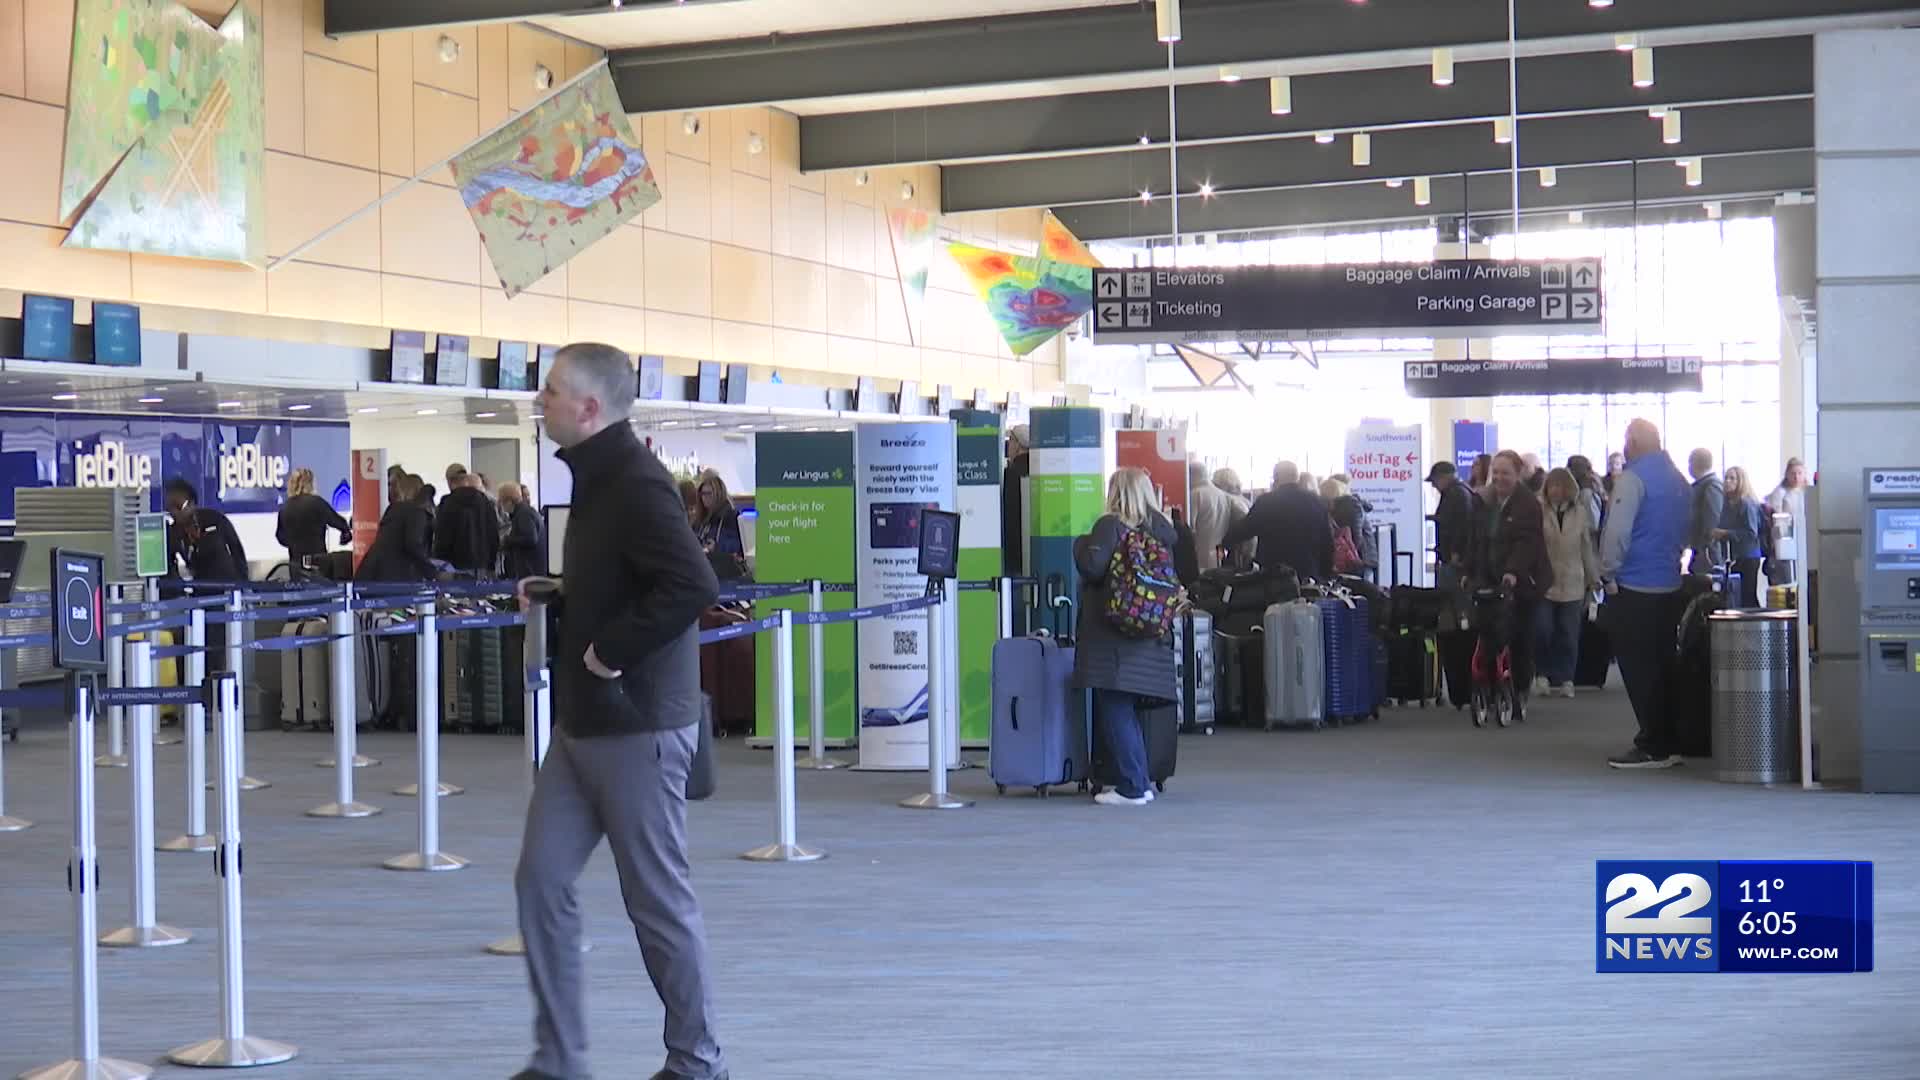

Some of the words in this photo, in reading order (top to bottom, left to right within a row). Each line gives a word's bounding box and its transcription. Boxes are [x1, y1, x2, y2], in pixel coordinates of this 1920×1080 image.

[1156, 271, 1225, 286] Elevators
[1346, 267, 1413, 284] Baggage
[1418, 266, 1461, 280] Claim
[1475, 264, 1530, 279] Arrivals
[1157, 300, 1222, 317] Ticketing
[1417, 296, 1475, 312] Parking
[1480, 295, 1536, 311] Garage
[1441, 363, 1481, 374] Baggage
[1483, 361, 1508, 371] Claim
[1515, 361, 1548, 371] Arrivals
[1622, 358, 1665, 369] Elevators
[880, 438, 927, 448] Breeze
[1366, 433, 1412, 442] Southwest
[1167, 436, 1177, 452] 1
[74, 440, 152, 489] jetBlue
[366, 457, 374, 473] 2
[1349, 453, 1401, 466] Self-Tag
[217, 443, 285, 501] jetBlue
[870, 464, 901, 472] Reward
[903, 463, 939, 473] yourself
[782, 471, 800, 480] Aer
[800, 471, 830, 481] Lingus
[872, 474, 897, 484] nicely
[899, 473, 919, 482] with
[920, 473, 935, 482] the
[964, 470, 988, 480] Class
[1350, 468, 1379, 479] Your
[1383, 468, 1413, 481] Bags
[866, 486, 893, 494] Breeze
[768, 502, 810, 512] Check-in
[811, 501, 825, 512] for
[768, 518, 790, 529] your
[791, 518, 818, 530] flight
[768, 533, 791, 544] here
[873, 557, 894, 565] Perks
[72, 606, 88, 620] Exit
[111, 692, 161, 700] INTERNATIONAL
[163, 691, 189, 699] AIRPORT
